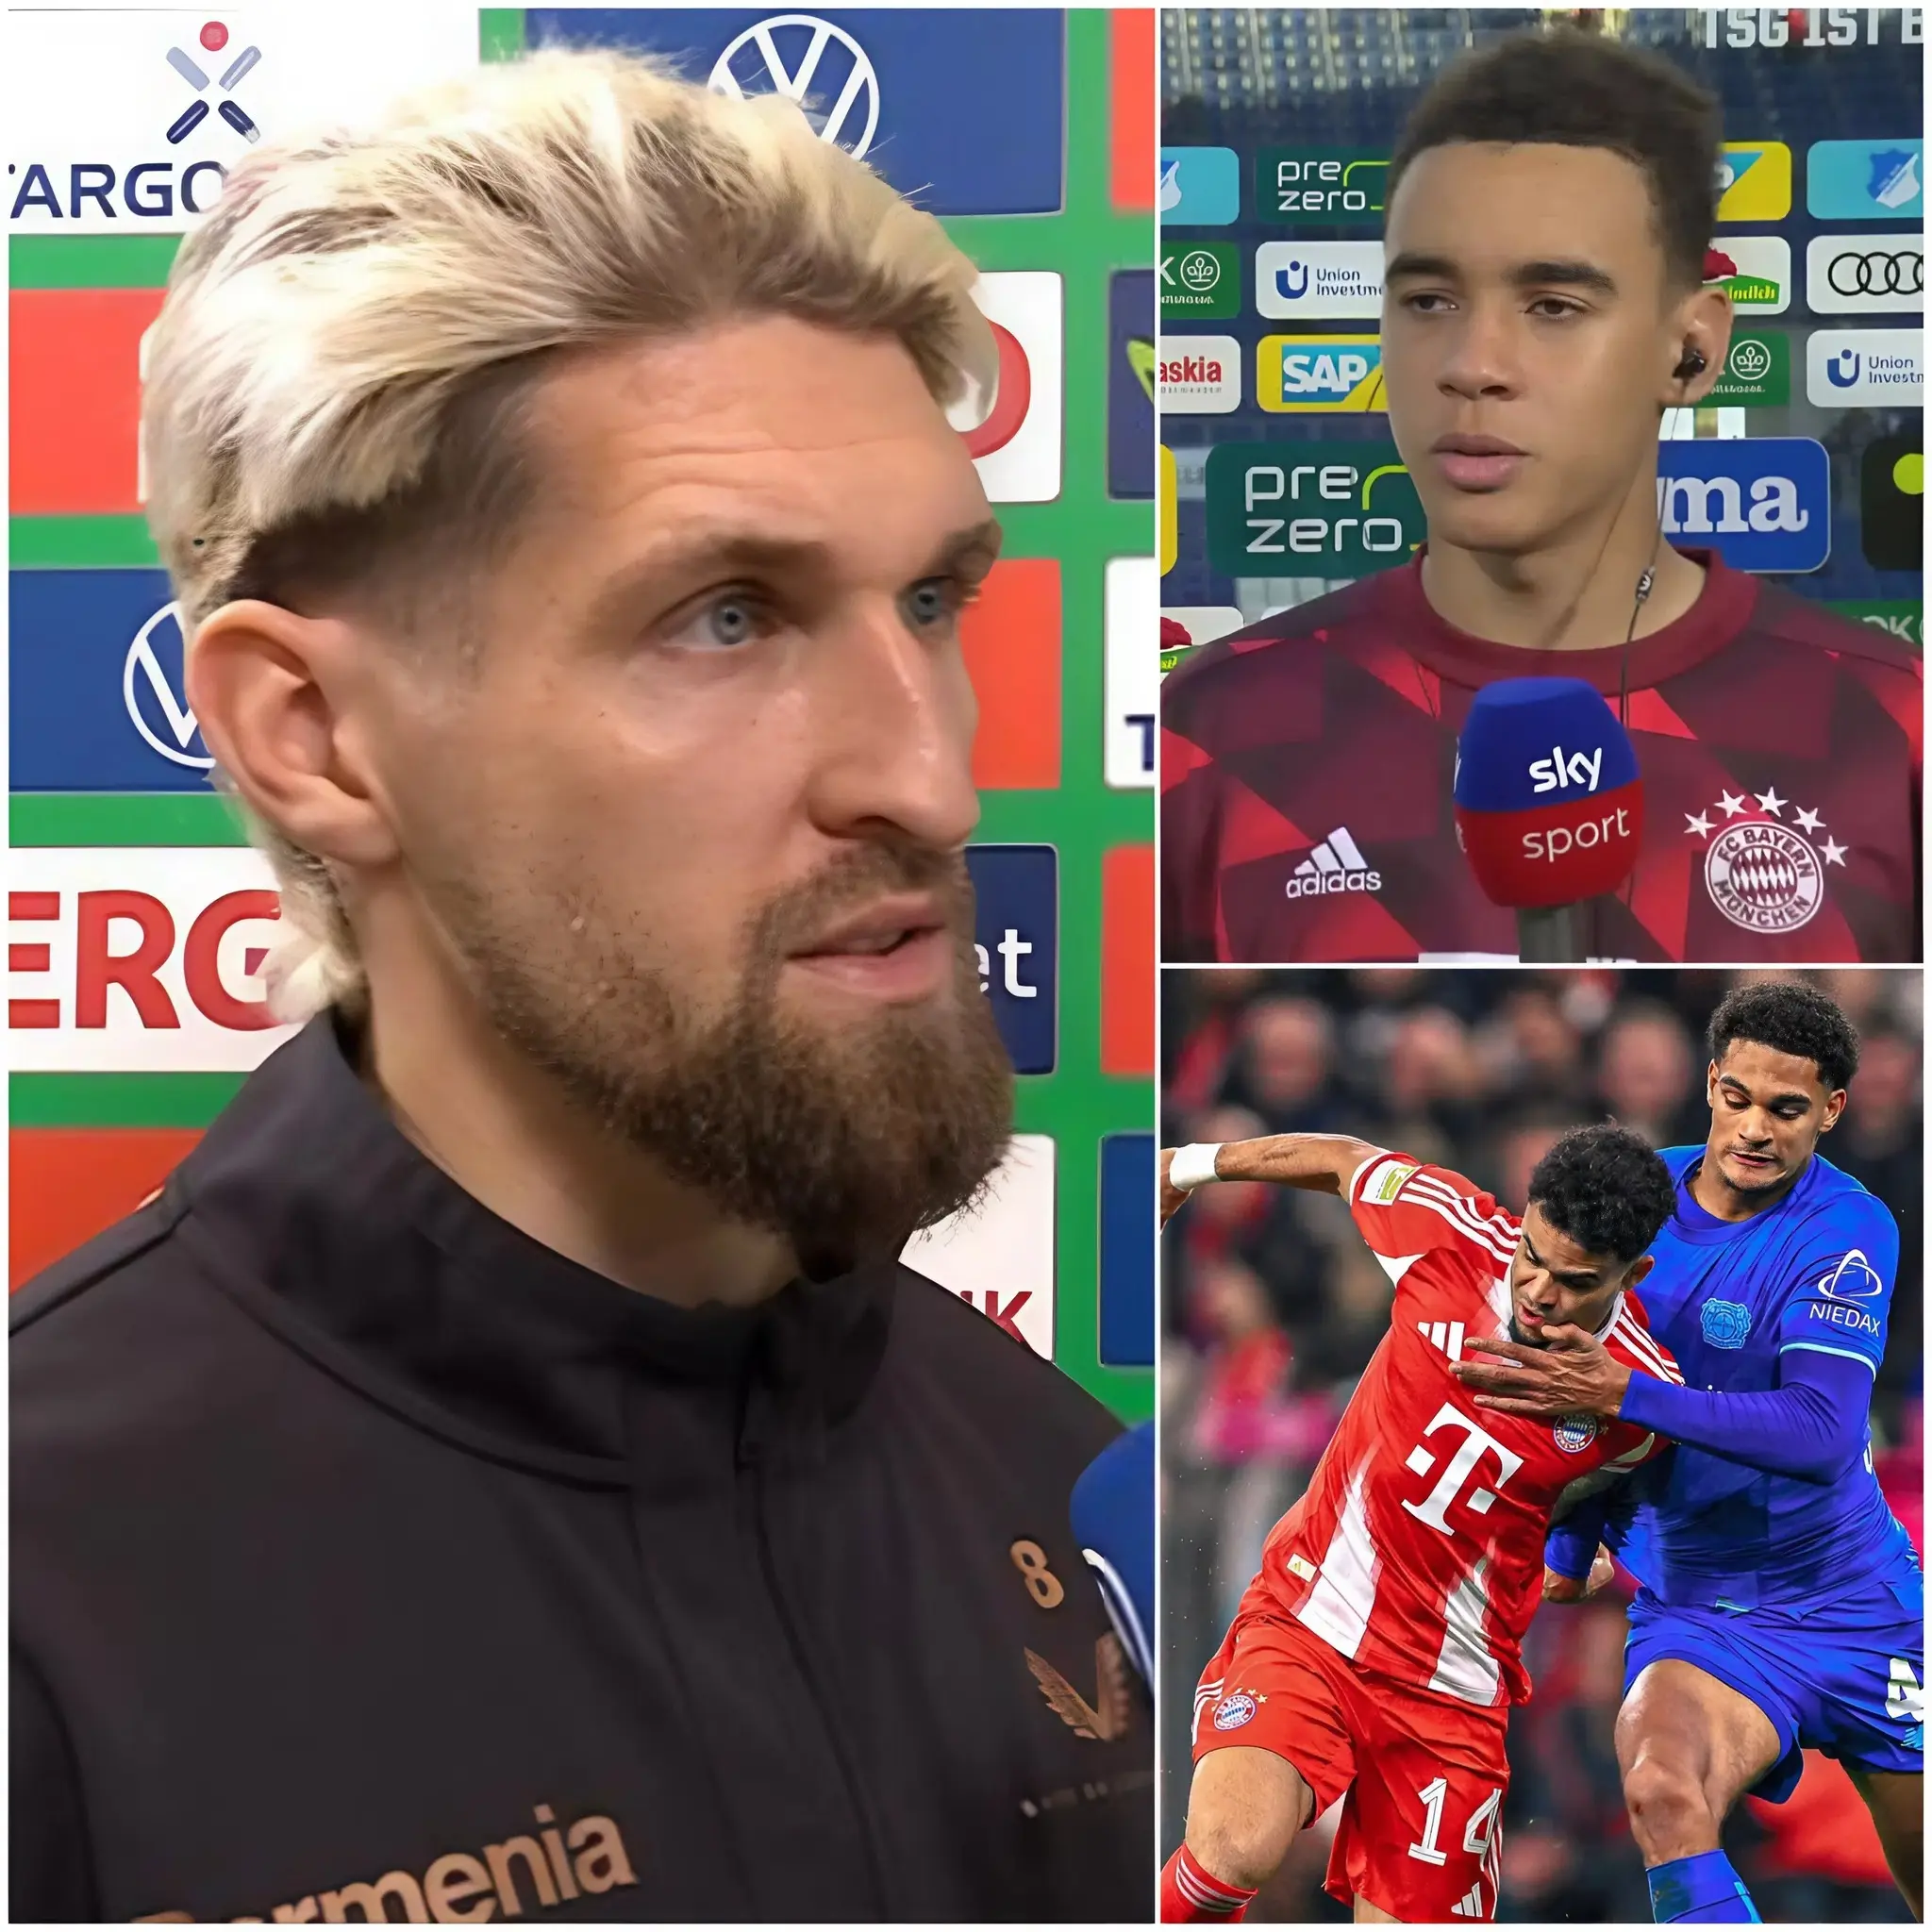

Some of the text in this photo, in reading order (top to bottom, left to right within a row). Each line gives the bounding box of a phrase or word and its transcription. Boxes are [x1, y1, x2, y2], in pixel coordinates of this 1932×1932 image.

[8, 160, 229, 219] ARGO
[1277, 160, 1341, 188] pre
[1277, 191, 1366, 211] zero
[1316, 268, 1360, 282] Union
[1316, 284, 1383, 296] Investm
[1283, 354, 1368, 393] SAP
[1869, 356, 1914, 370] Union
[1245, 465, 1358, 512] pre
[1245, 518, 1403, 553] zero
[1528, 745, 1602, 793] sky
[1522, 808, 1630, 863] sport
[1742, 828, 1815, 878] BAYERN
[1286, 868, 1382, 899] adidas
[1809, 1303, 1881, 1338] NIEDAX
[1010, 1540, 1064, 1609] 8
[130, 1804, 639, 1924] rmenia
